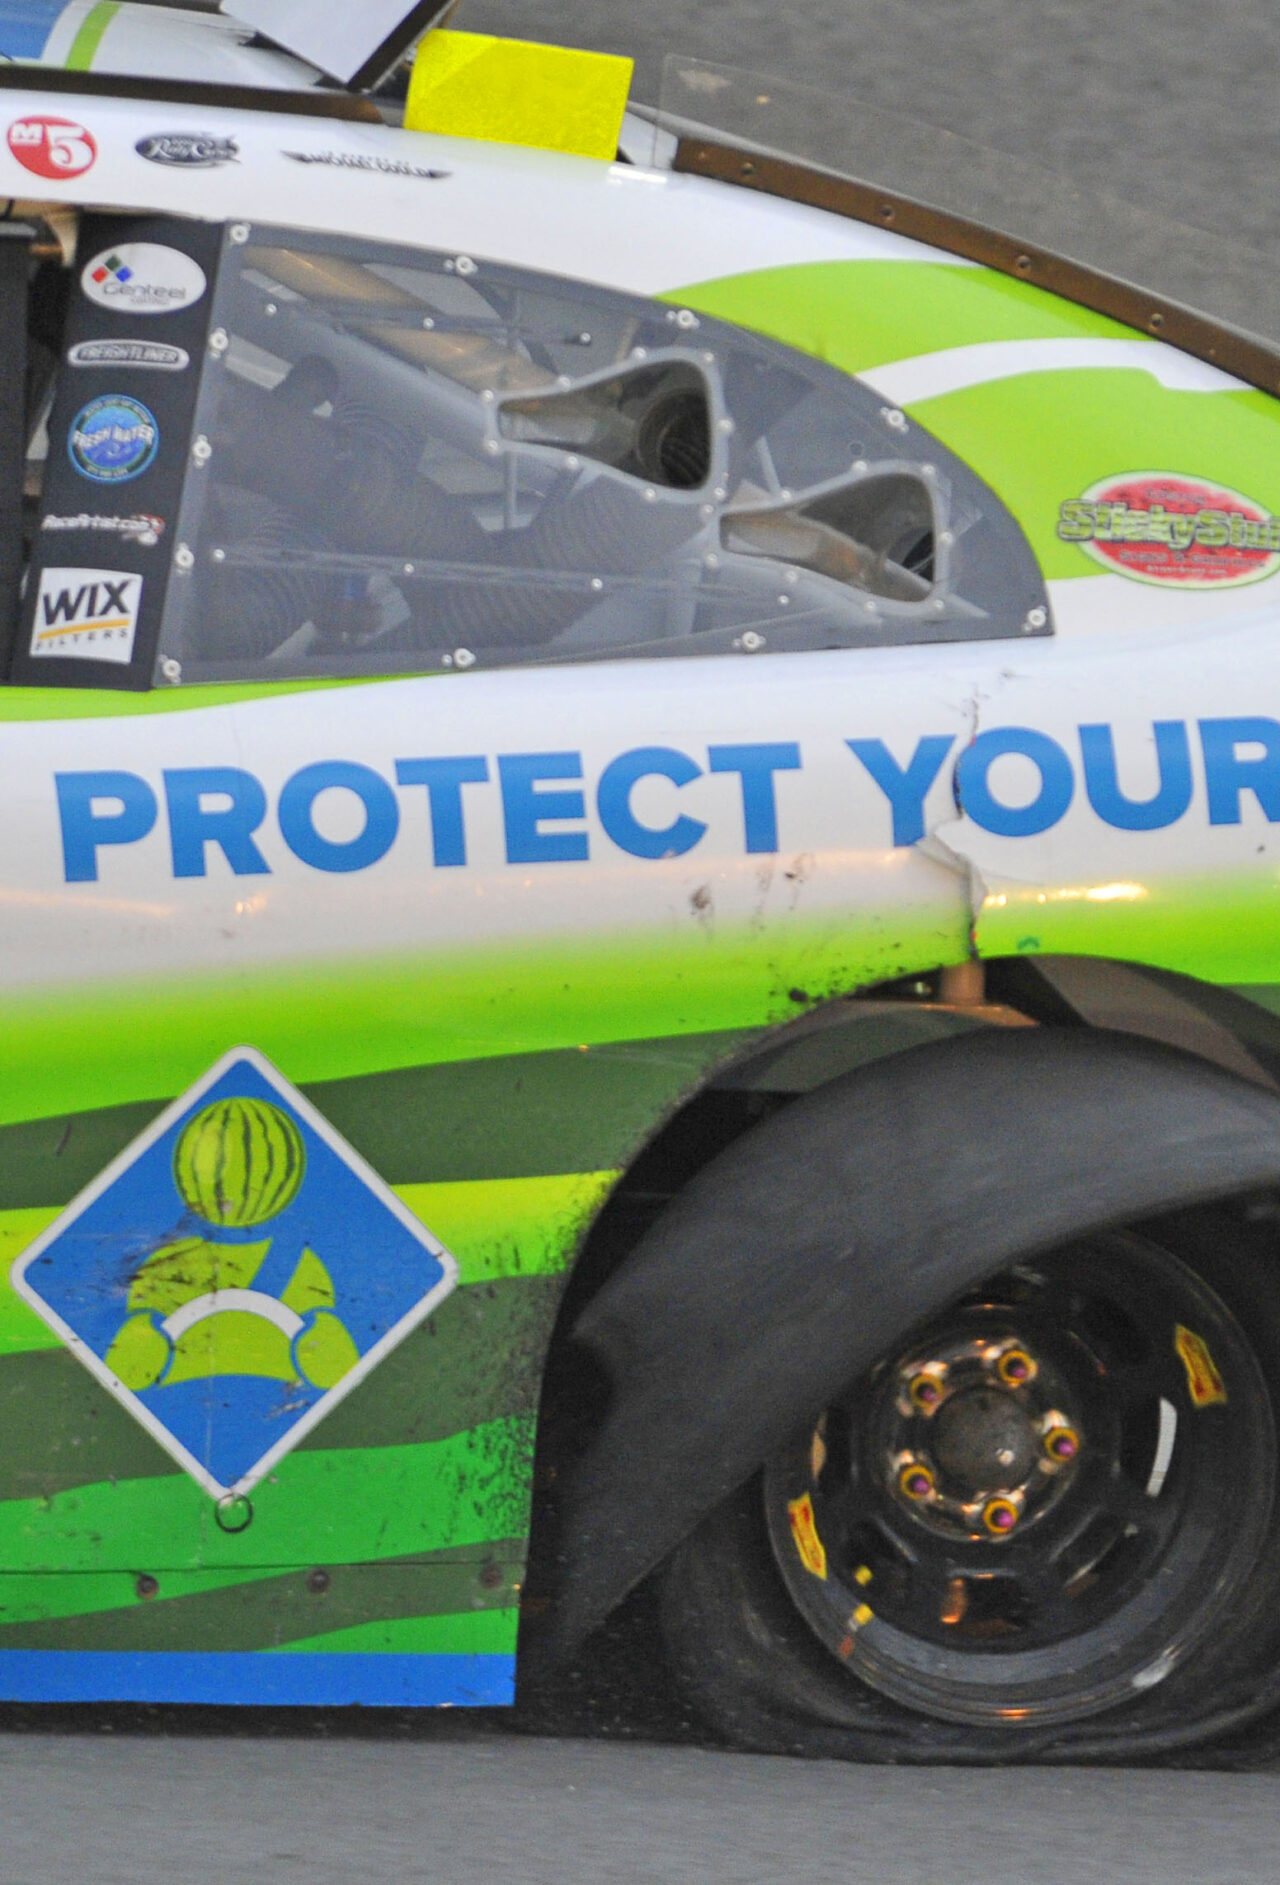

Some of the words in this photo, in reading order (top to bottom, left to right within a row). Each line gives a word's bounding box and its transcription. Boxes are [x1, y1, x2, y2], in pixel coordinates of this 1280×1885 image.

[42, 578, 133, 627] WIX
[35, 629, 129, 651] FILTERS
[53, 741, 803, 883] PROTECT
